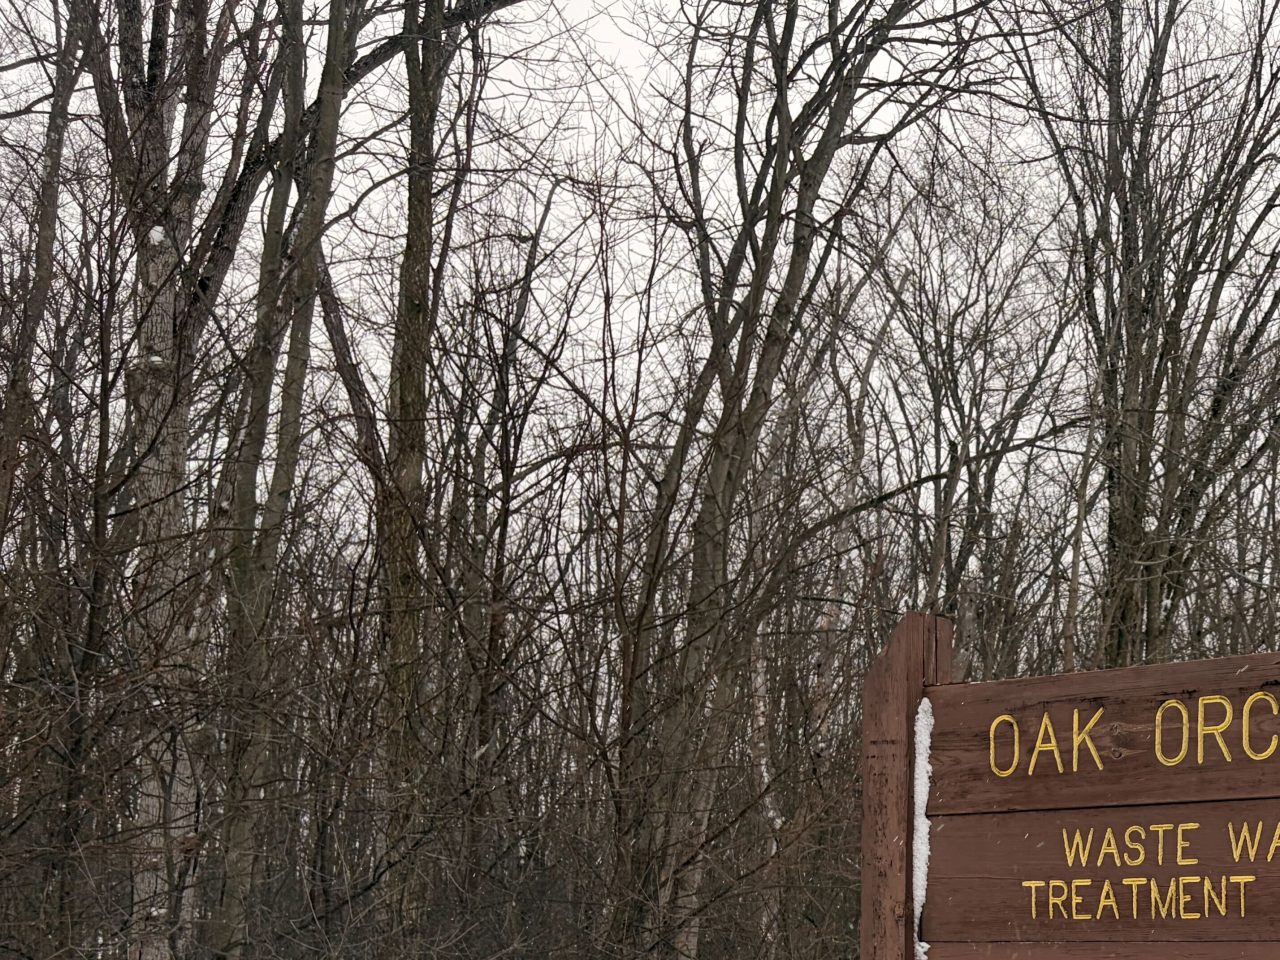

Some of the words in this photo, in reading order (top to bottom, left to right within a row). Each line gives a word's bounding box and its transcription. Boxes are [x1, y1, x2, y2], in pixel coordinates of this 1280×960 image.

[988, 706, 1106, 779] OAK
[1062, 822, 1202, 868] WASTE
[1021, 873, 1257, 921] TREATMENT
